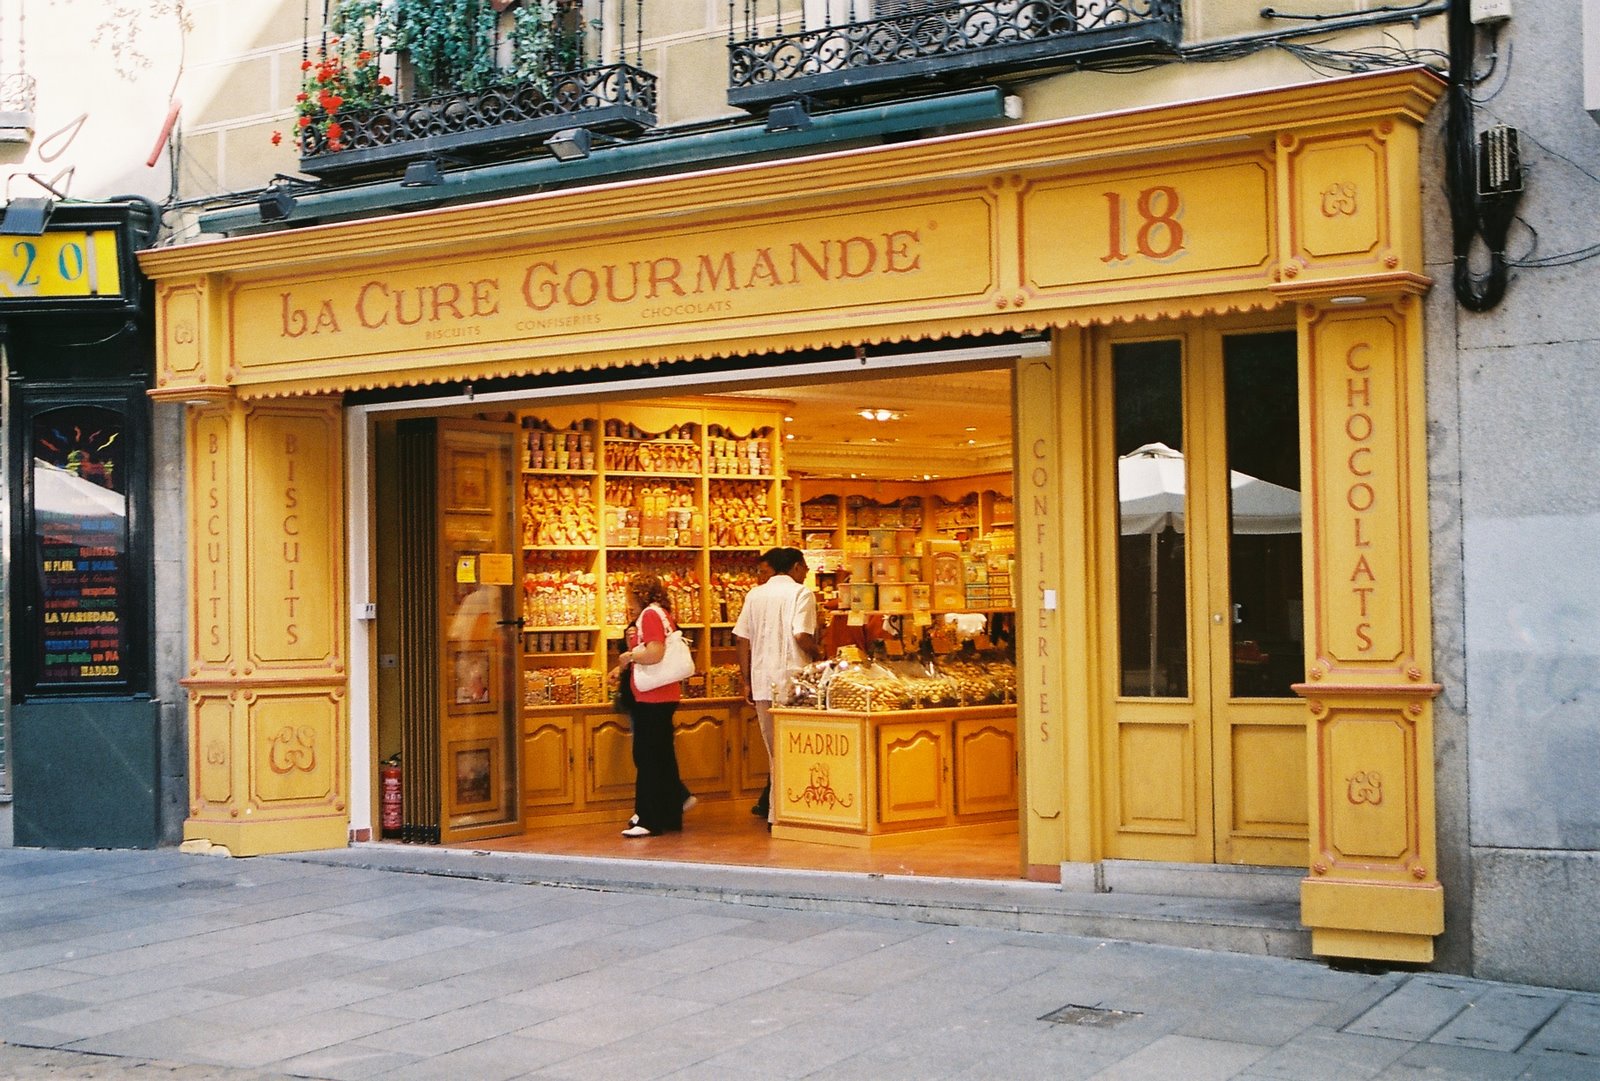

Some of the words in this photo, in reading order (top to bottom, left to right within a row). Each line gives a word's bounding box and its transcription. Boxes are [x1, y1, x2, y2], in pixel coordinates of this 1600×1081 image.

[1100, 185, 1186, 263] 18
[13, 241, 83, 286] 20
[280, 291, 341, 338] LA
[354, 278, 500, 330] CURE
[521, 229, 922, 311] GOURMANDE
[425, 325, 482, 341] BISCUITS
[515, 314, 601, 332] CONFISERIES
[641, 300, 733, 319] CHOCOLATS
[1345, 342, 1375, 652] CHOCOLATS
[208, 433, 222, 646] BISCUITS
[283, 433, 301, 646] BISCUITS
[1032, 438, 1050, 743] CONFISERIES
[789, 732, 849, 756] MADRID
